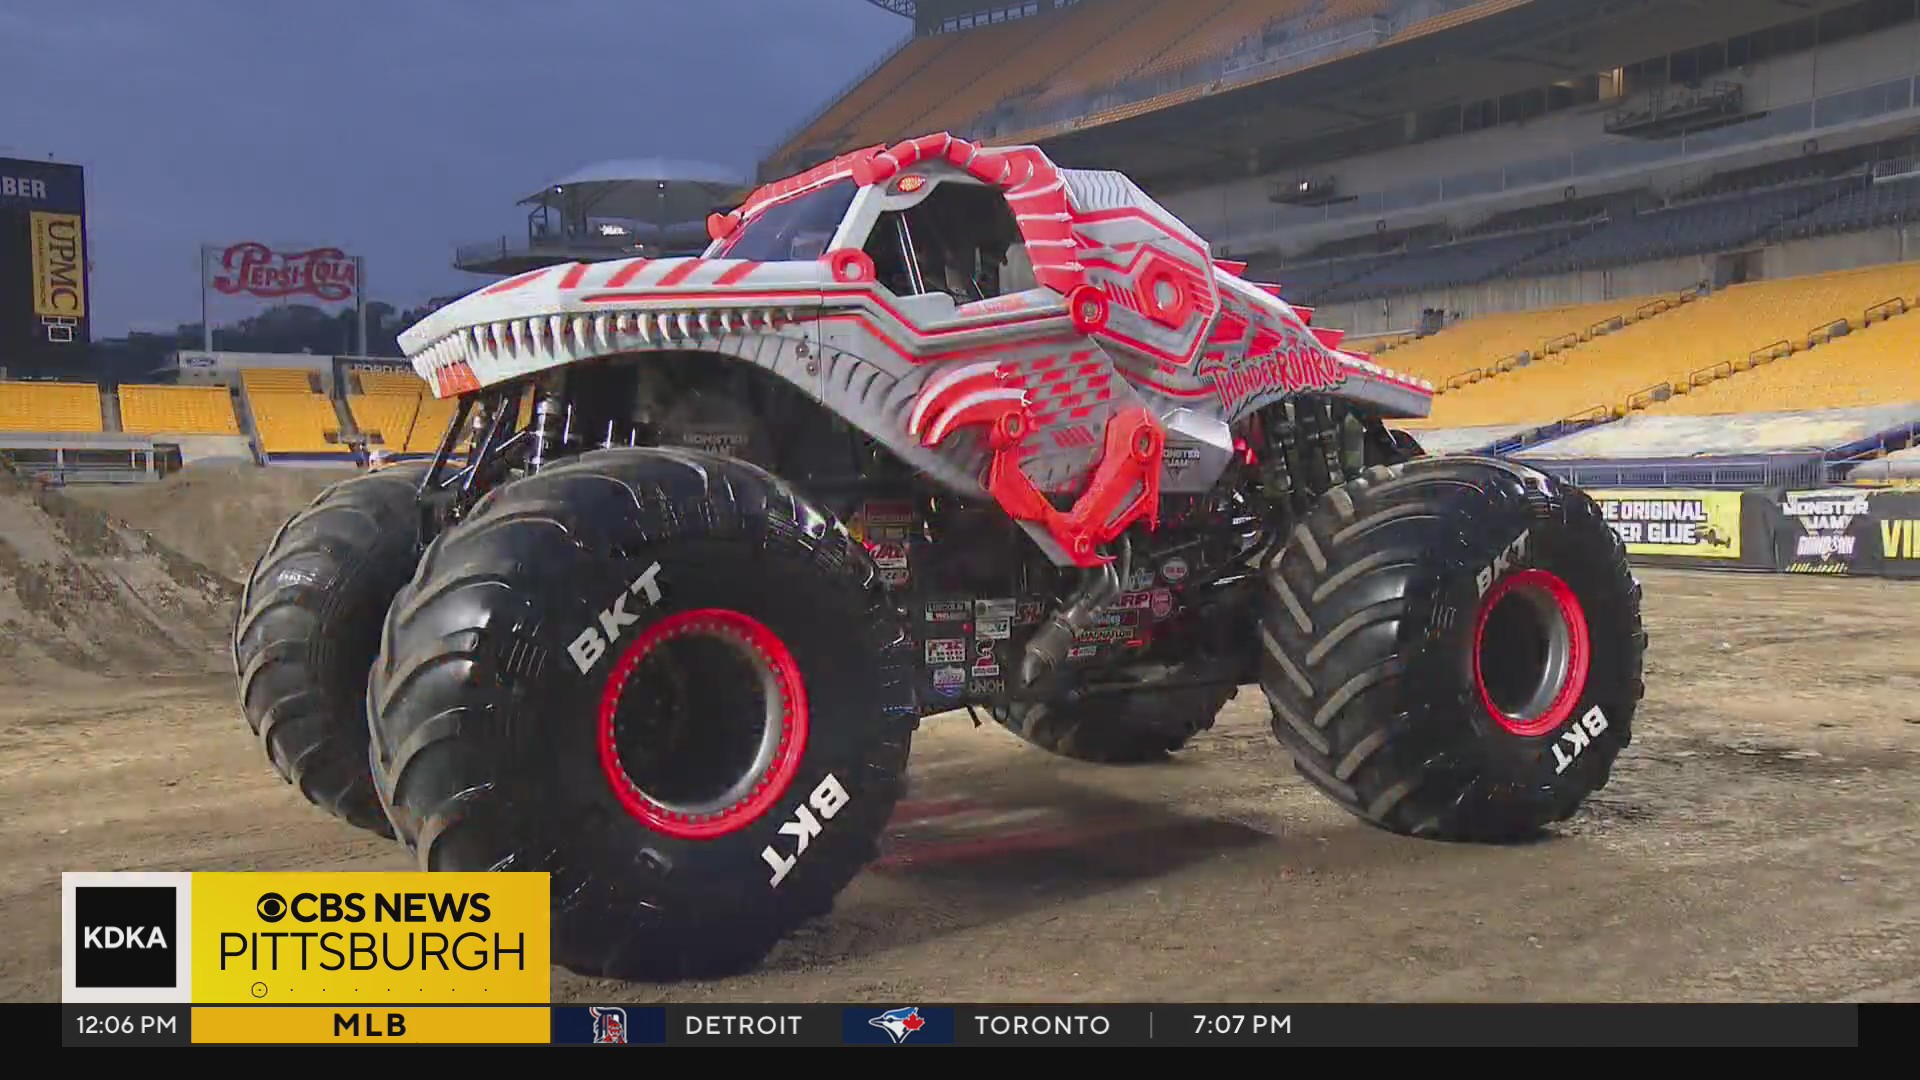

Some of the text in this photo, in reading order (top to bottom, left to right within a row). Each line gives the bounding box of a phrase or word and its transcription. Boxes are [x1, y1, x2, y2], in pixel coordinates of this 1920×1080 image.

[0, 176, 47, 198] BER
[48, 219, 78, 310] UPMC
[1163, 448, 1200, 460] ONSTER
[1596, 500, 1707, 521] HE ORIGINAL
[1781, 499, 1870, 516] MONSTER
[1647, 522, 1697, 545] GLUE
[1476, 528, 1530, 598] BKT
[567, 561, 661, 675] BKT
[1551, 705, 1609, 775] BKT
[762, 773, 850, 888] BKT
